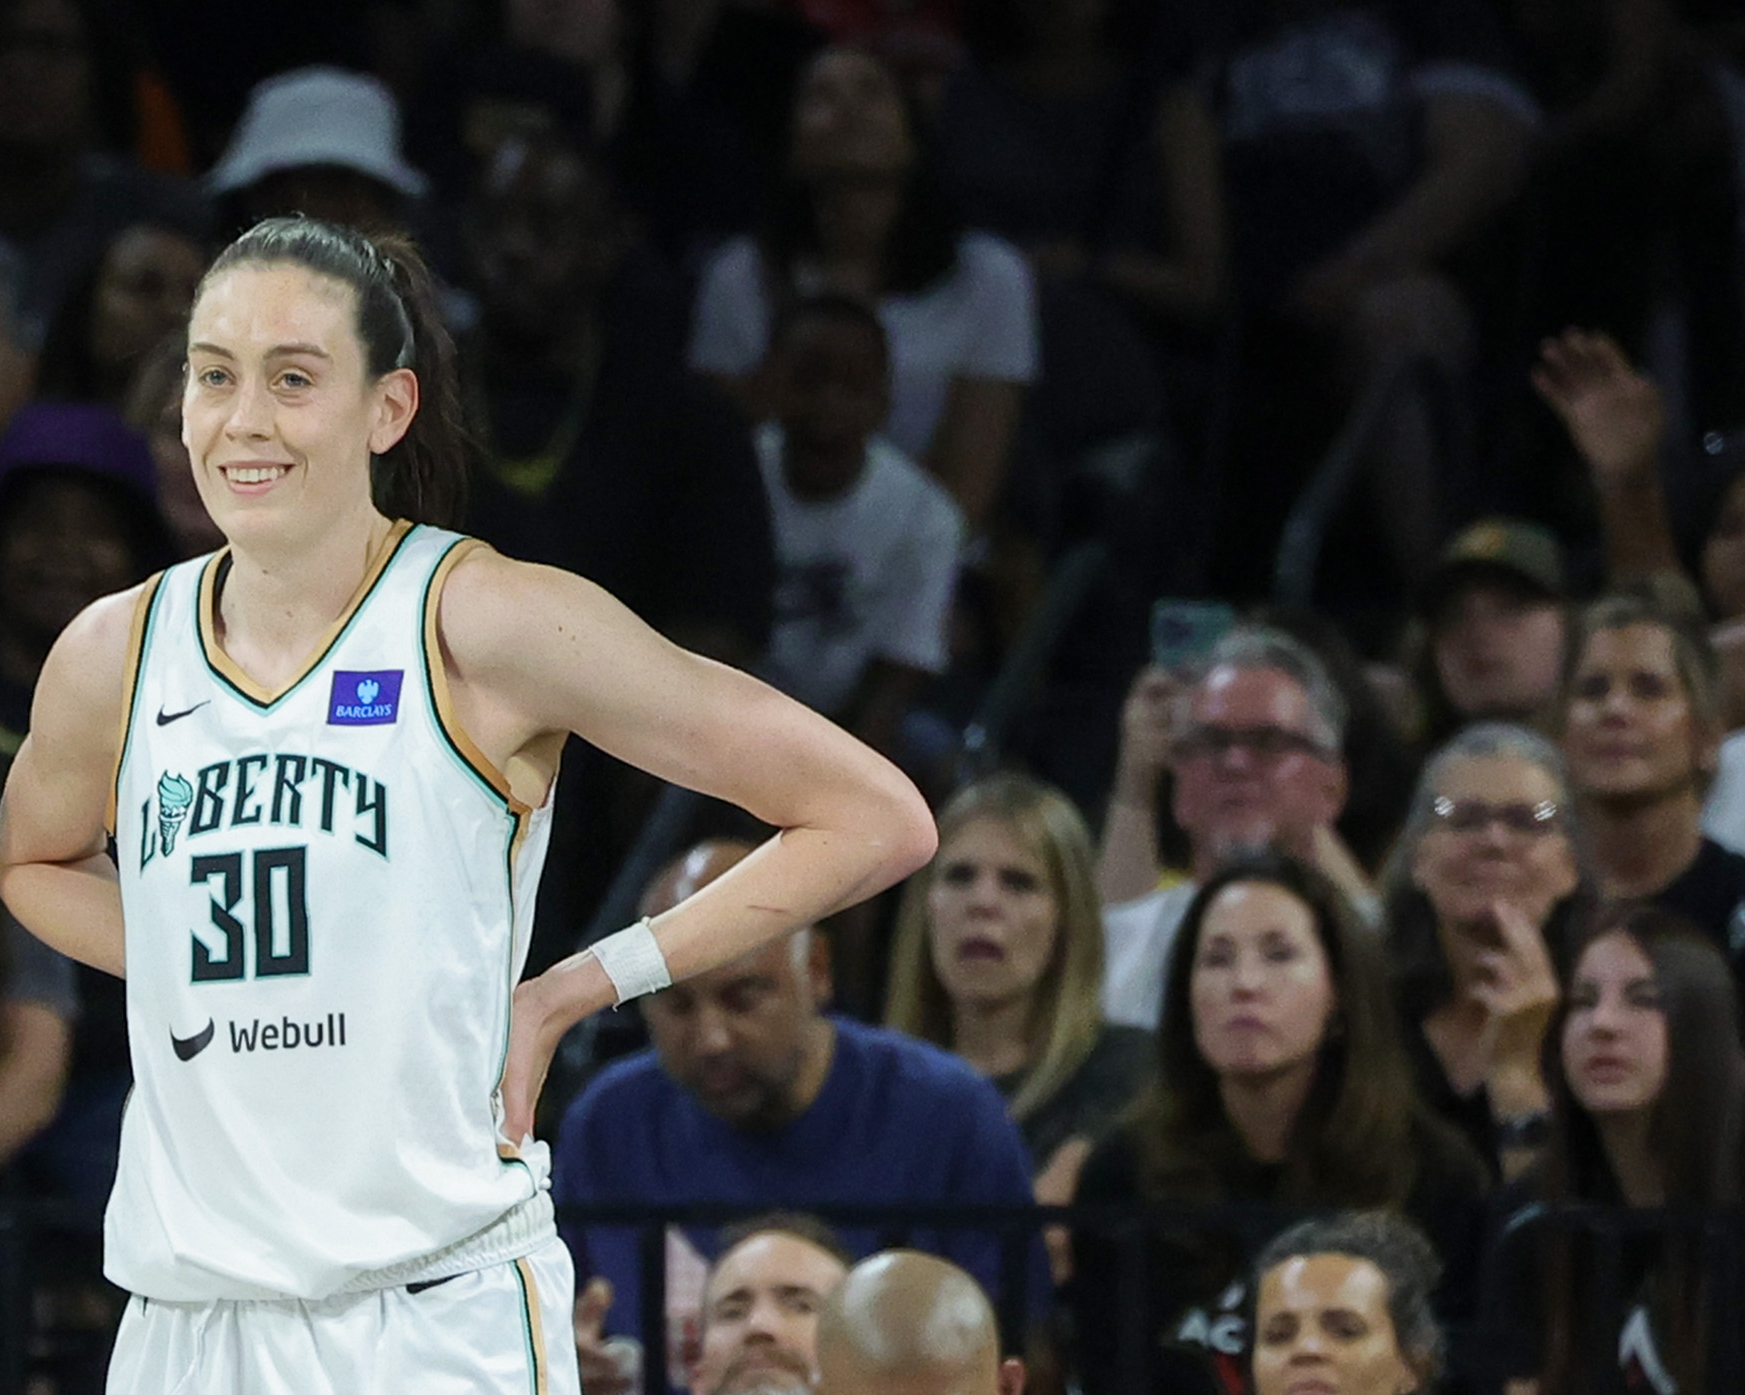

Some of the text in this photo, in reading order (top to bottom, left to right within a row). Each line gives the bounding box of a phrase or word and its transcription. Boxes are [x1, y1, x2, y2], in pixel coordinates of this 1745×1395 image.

[335, 702, 392, 719] BARCLAYS
[189, 844, 311, 985] 30
[229, 1012, 346, 1053] Webull
